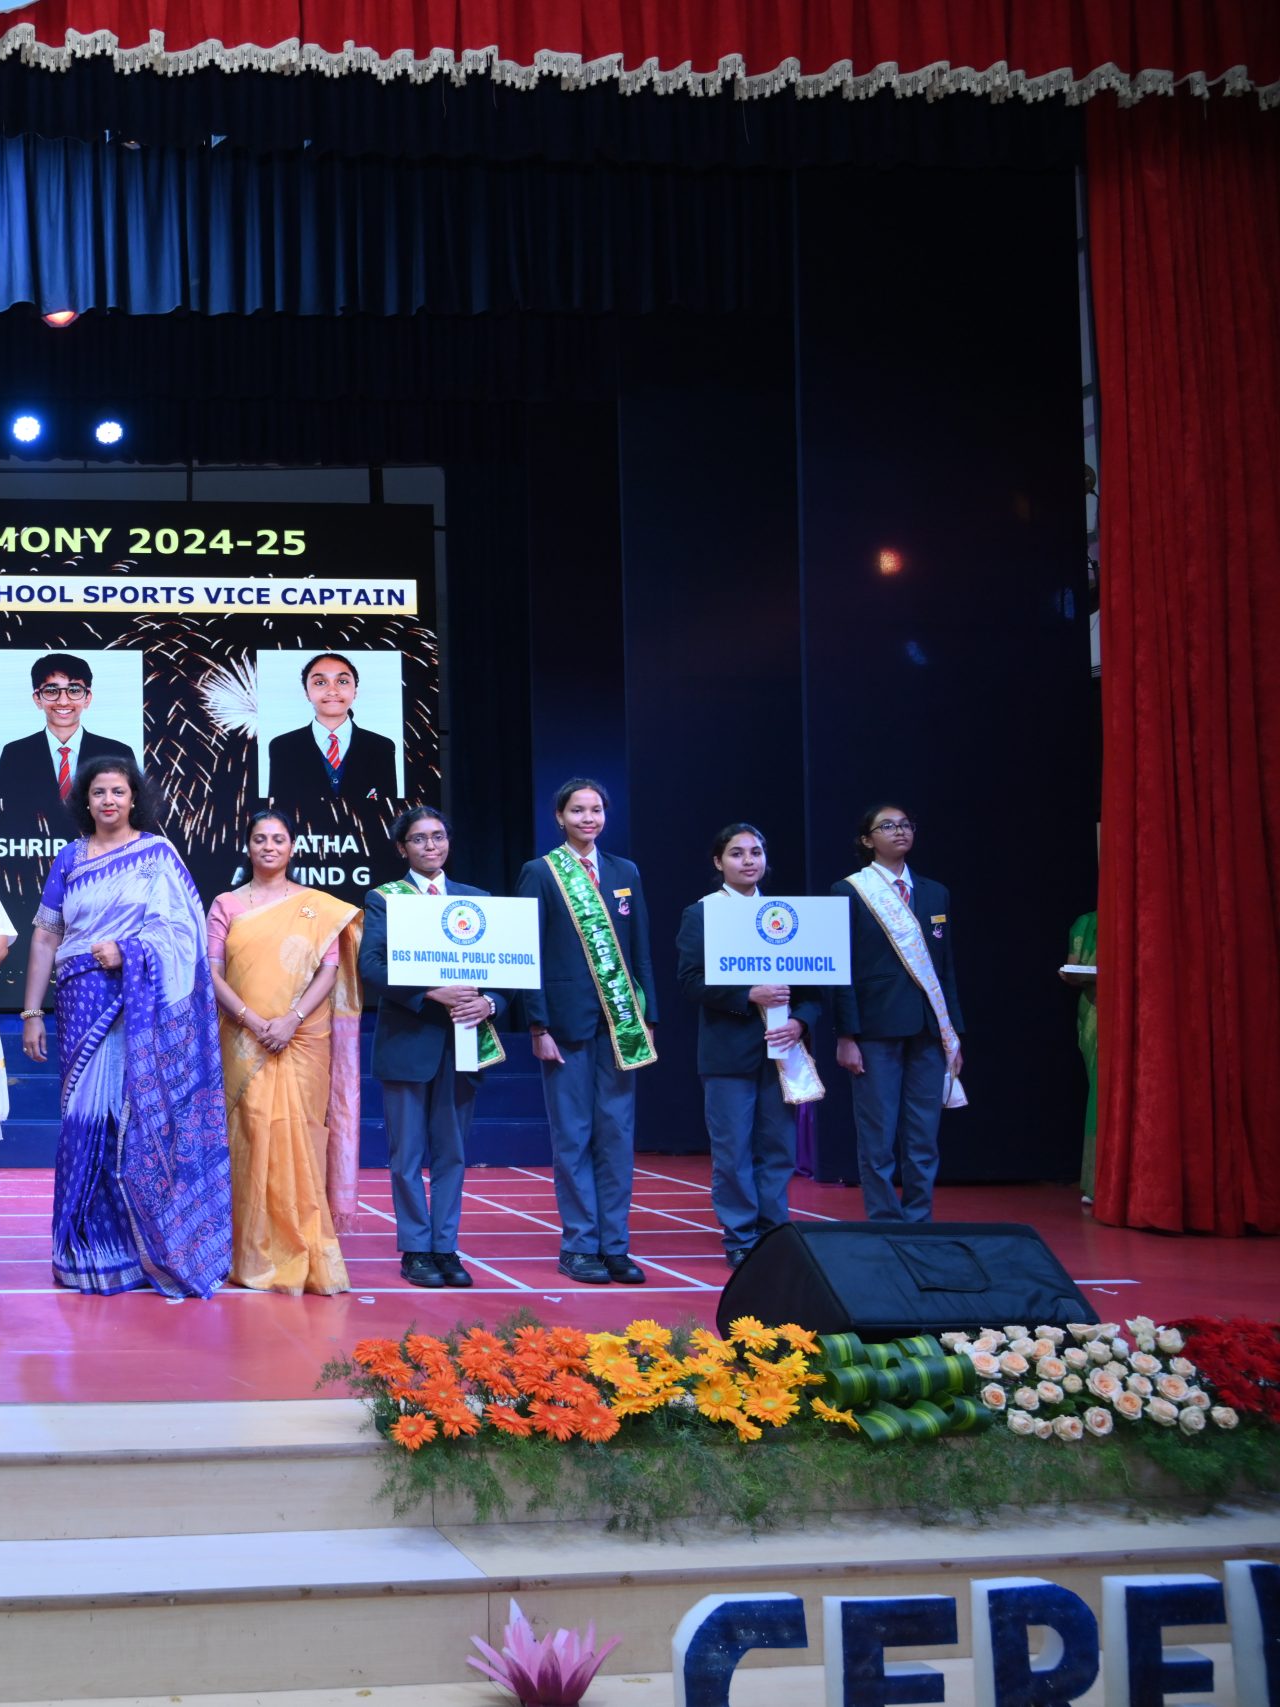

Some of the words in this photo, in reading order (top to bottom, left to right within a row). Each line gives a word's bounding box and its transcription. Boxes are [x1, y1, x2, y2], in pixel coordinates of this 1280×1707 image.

[128, 527, 306, 556] 2024-25
[82, 585, 195, 605] SPORTS
[204, 587, 270, 605] VICE
[280, 588, 406, 606] CAPTAIN
[352, 867, 370, 886] G
[392, 949, 411, 962] BGS
[414, 950, 460, 963] NATIONAL
[462, 951, 496, 964] PUBLIC
[498, 952, 536, 965] SCHOOL
[719, 956, 772, 972] SPORTS
[775, 956, 836, 972] COUNCIL
[440, 967, 488, 980] HULIMAVU
[591, 924, 616, 972] LEADER
[607, 979, 632, 1021] GIRLS
